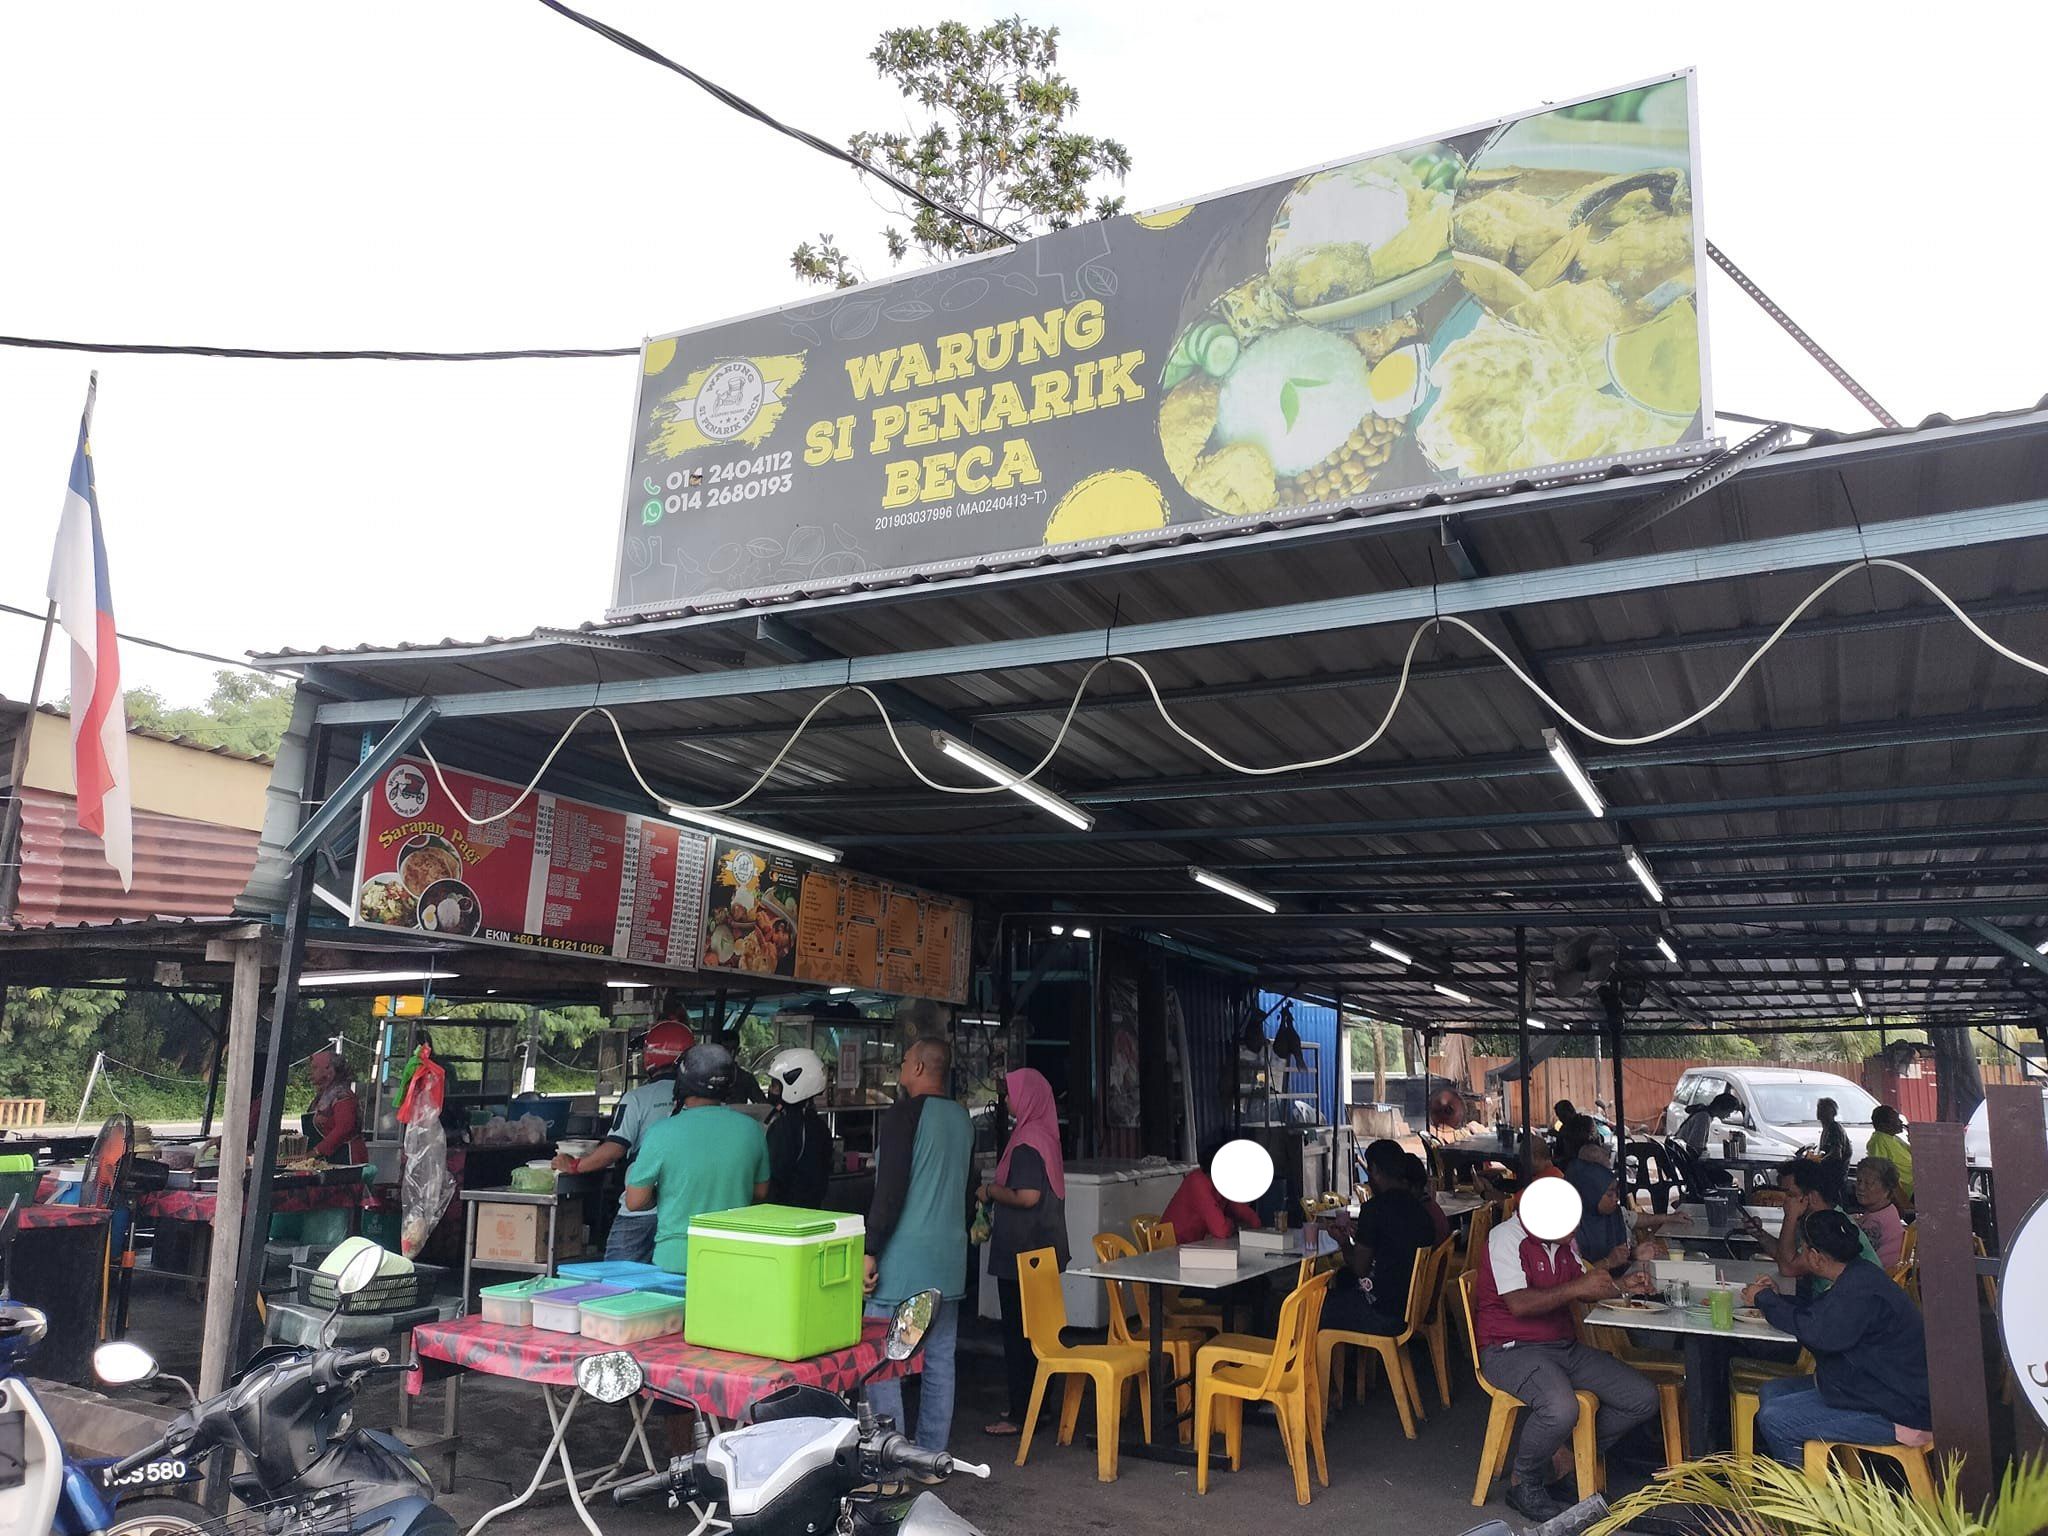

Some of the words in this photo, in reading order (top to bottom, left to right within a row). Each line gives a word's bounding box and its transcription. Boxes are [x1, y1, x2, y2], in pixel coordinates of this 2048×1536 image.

[845, 299, 1105, 401] WARUNG
[705, 363, 755, 393] WARUNG
[701, 416, 742, 435] PENARIK
[742, 393, 761, 424] BECA
[803, 415, 857, 467] SI
[869, 349, 1146, 455] PENARIK
[708, 450, 793, 484] 2404112
[881, 437, 1043, 510] BECA
[664, 491, 702, 513] 014
[706, 473, 793, 508] 2680193
[874, 505, 953, 531] 201903037996
[955, 489, 1048, 518] (MA0240413-T)
[378, 821, 445, 849] Sarapan
[450, 829, 481, 866] Pagi
[485, 929, 511, 942] EKIN
[513, 934, 533, 945] +60
[536, 936, 549, 947] 11
[552, 938, 578, 951] 6121
[580, 942, 605, 955] 0102
[146, 1460, 186, 1482] 580
